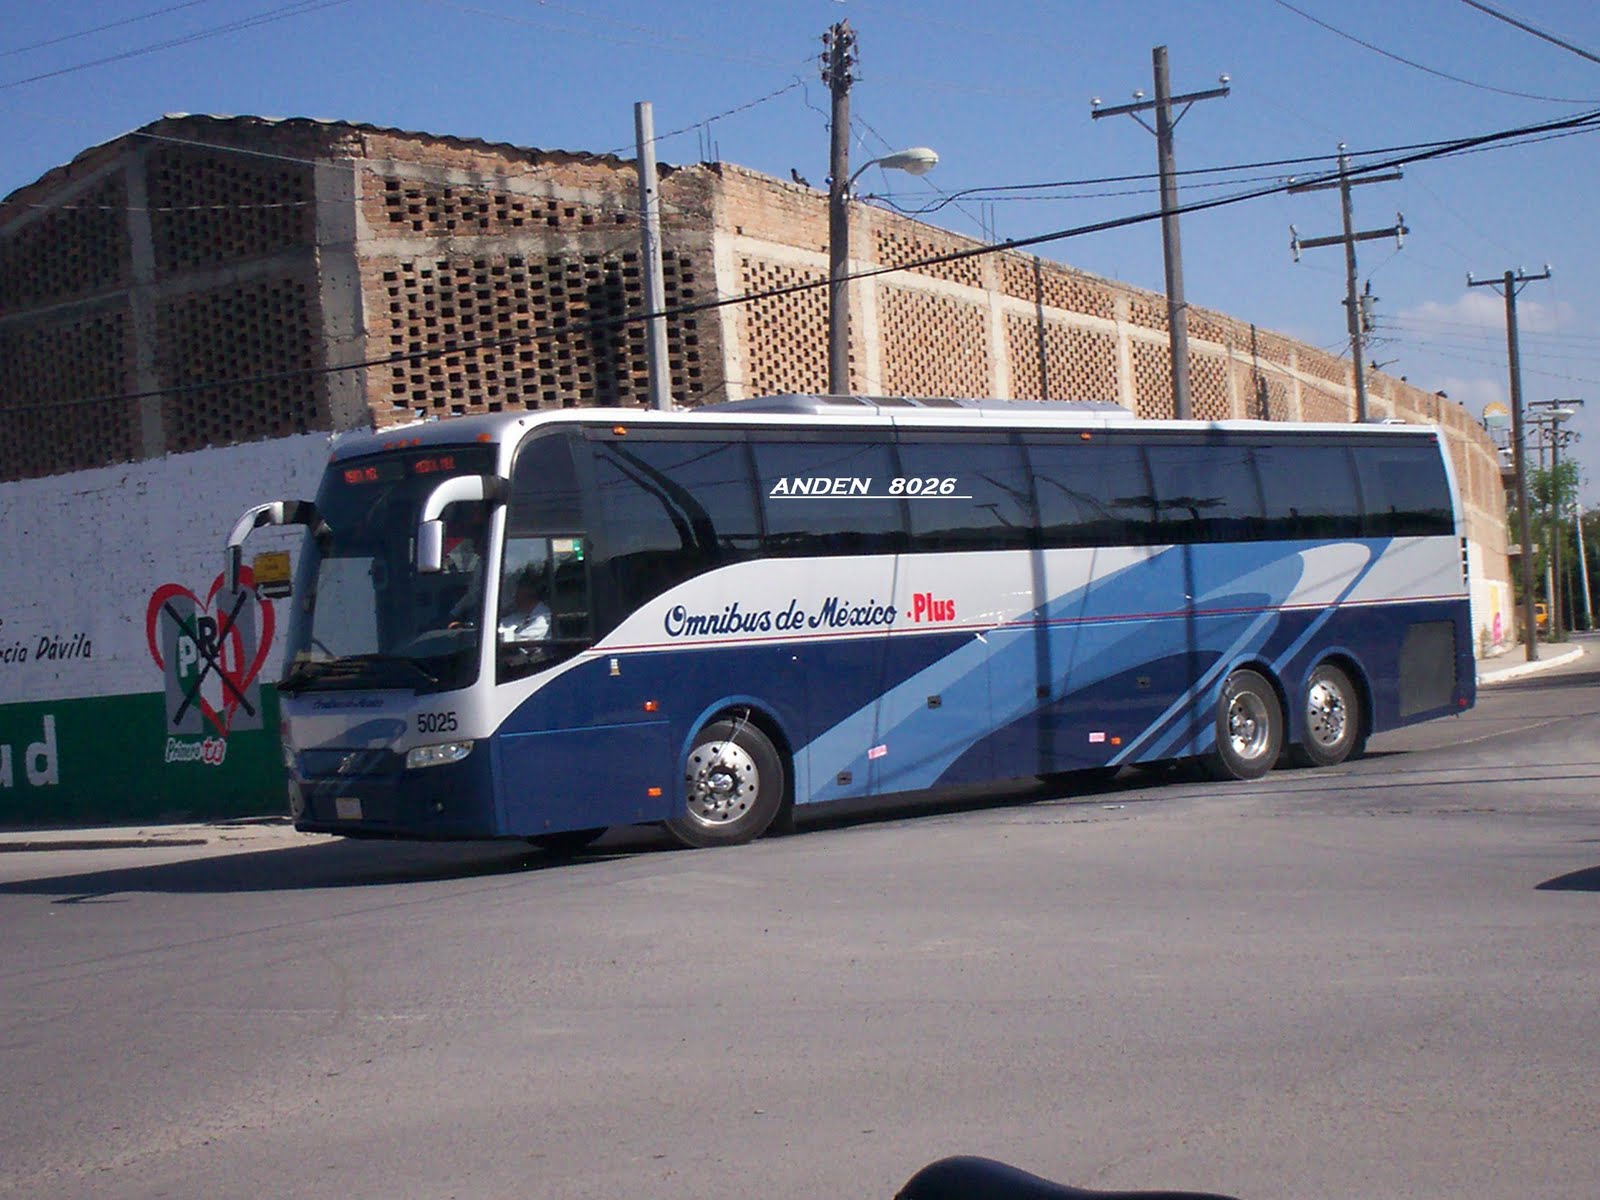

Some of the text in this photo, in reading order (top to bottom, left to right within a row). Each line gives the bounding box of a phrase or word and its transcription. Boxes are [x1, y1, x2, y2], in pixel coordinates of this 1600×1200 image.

[664, 602, 771, 637] Omnibus
[775, 599, 805, 630] de
[808, 597, 897, 629] México
[0, 632, 92, 664] cia Dávila
[417, 711, 458, 733] 5025
